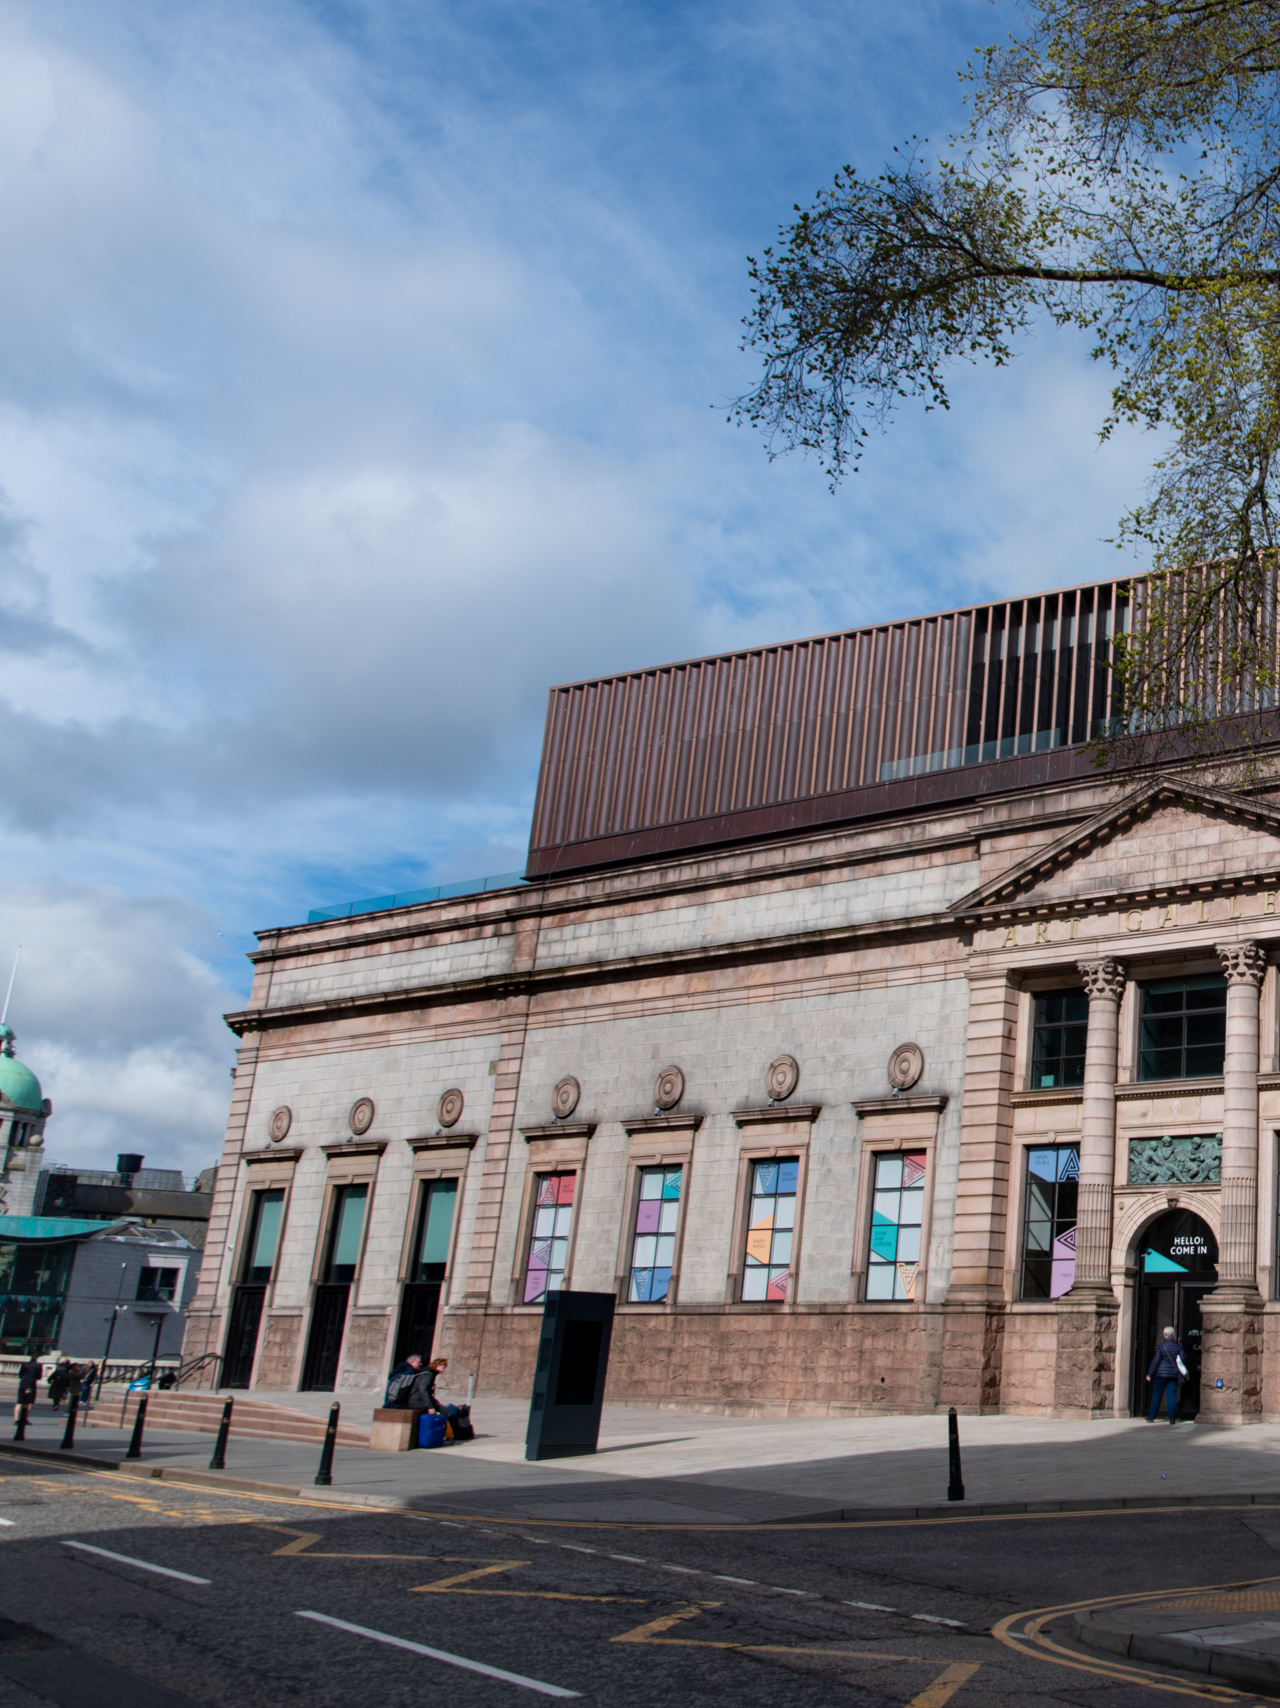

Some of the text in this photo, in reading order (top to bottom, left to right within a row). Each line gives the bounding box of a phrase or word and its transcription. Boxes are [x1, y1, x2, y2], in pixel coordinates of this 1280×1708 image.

[1002, 917, 1081, 948] ART
[1173, 1236, 1204, 1245] HELLO!
[1170, 1246, 1208, 1255] COME IN
